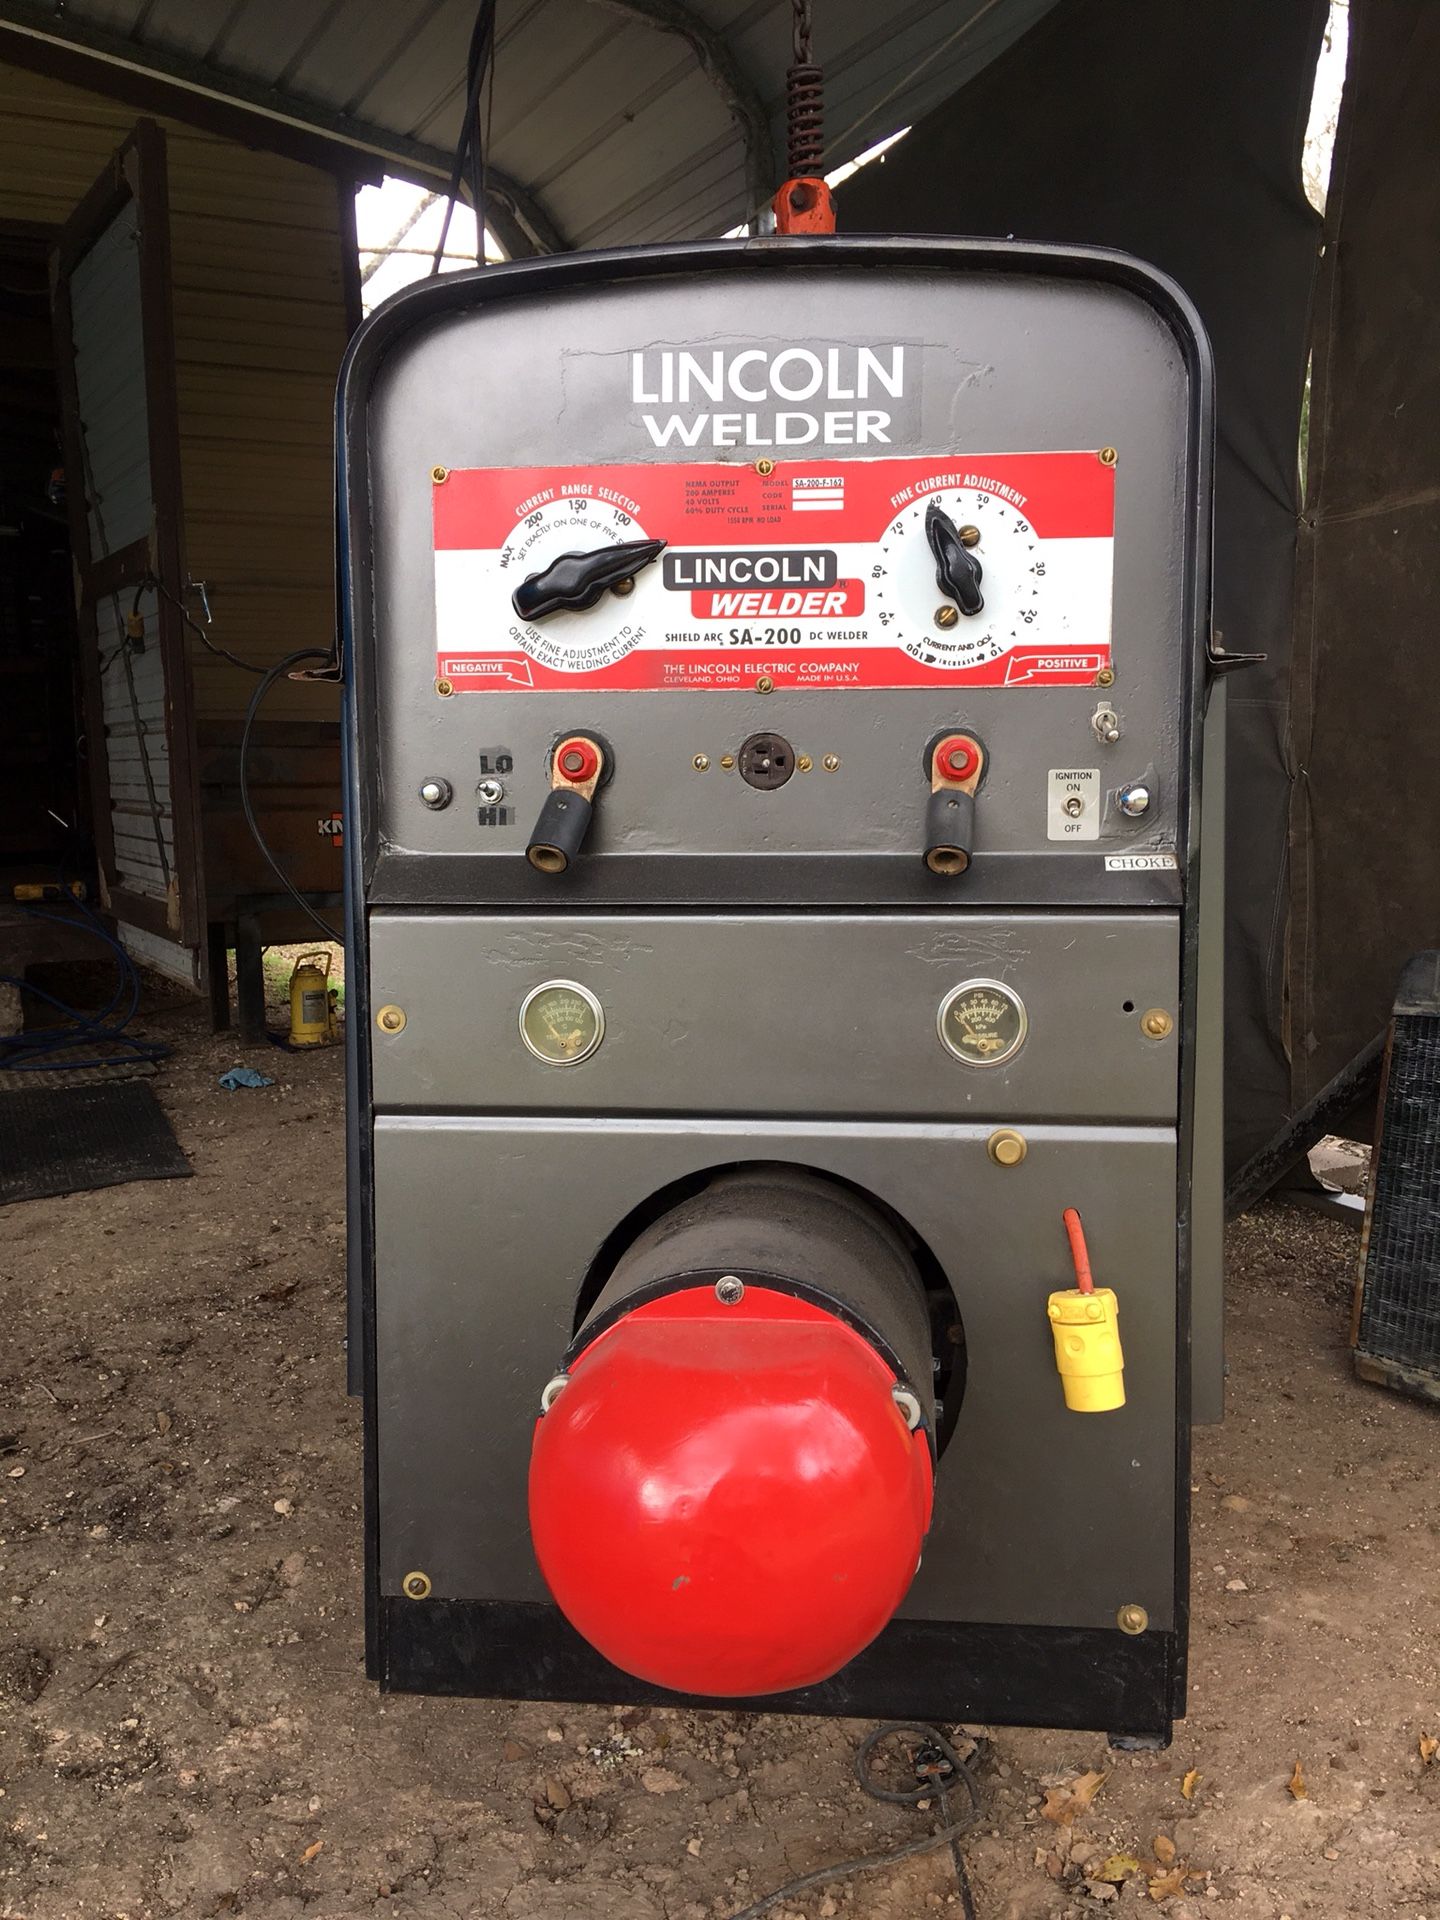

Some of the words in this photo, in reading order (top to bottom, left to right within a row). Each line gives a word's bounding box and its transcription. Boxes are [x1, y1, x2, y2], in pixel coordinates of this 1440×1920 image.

[633, 346, 904, 403] LINCOLN
[642, 410, 892, 447] WELDER
[795, 479, 843, 487] SA-200-F-162
[890, 489, 913, 508] FINE
[915, 474, 961, 494] CURRENT
[963, 473, 1028, 508] ADJUSTMENT
[515, 488, 555, 517] CURRENT
[561, 484, 593, 495] RANGE
[598, 487, 641, 516] SELECTOR
[568, 500, 587, 510] 150
[930, 495, 942, 506] 60
[976, 494, 990, 504] 50
[524, 511, 543, 529] 200
[612, 509, 631, 526] 100
[890, 521, 903, 534] 70
[1016, 519, 1029, 533] 40
[518, 547, 527, 561] SET
[525, 523, 551, 547] EXACTLY
[553, 520, 568, 528] ON
[569, 518, 588, 526] ONE
[590, 521, 601, 529] OF
[602, 526, 618, 540] FIVE
[500, 545, 515, 569] MAX
[674, 556, 826, 584] LINCOLN
[872, 565, 882, 579] 80
[1036, 562, 1046, 576] 30
[710, 591, 848, 617] WELDER
[1024, 609, 1038, 624] 20
[525, 626, 542, 643] USE
[541, 640, 561, 655] FINE
[562, 636, 620, 659] ADJUSTMENT
[620, 626, 632, 638] TO
[665, 632, 701, 642] SHIELD
[704, 632, 724, 642] ARC
[729, 628, 801, 645] SA-200
[809, 632, 825, 640] DC
[827, 631, 868, 640] WELDER
[509, 627, 537, 655] OBTAIN
[537, 653, 565, 668] EXACT
[567, 655, 610, 670] WELDING
[612, 626, 647, 660] CURRENT
[923, 636, 956, 652] CURRENT
[957, 643, 975, 651] AND
[906, 643, 924, 661] 100
[990, 647, 1003, 657] 10
[452, 663, 504, 672] NEGATIVE
[663, 664, 685, 675] THE
[688, 663, 741, 674] LINCOLN
[744, 663, 796, 674] ELECTRIC
[799, 662, 861, 673] COMPANY
[938, 657, 976, 666] INCREASE
[1037, 659, 1088, 668] POSITIVE
[715, 675, 740, 683] OHIO
[824, 674, 834, 682] IN
[480, 755, 513, 775] LO
[1055, 772, 1092, 780] IGNITION
[1066, 784, 1081, 792] ON
[478, 807, 508, 826] HI
[1064, 824, 1082, 833] OFF
[1109, 857, 1174, 869] CHOKE
